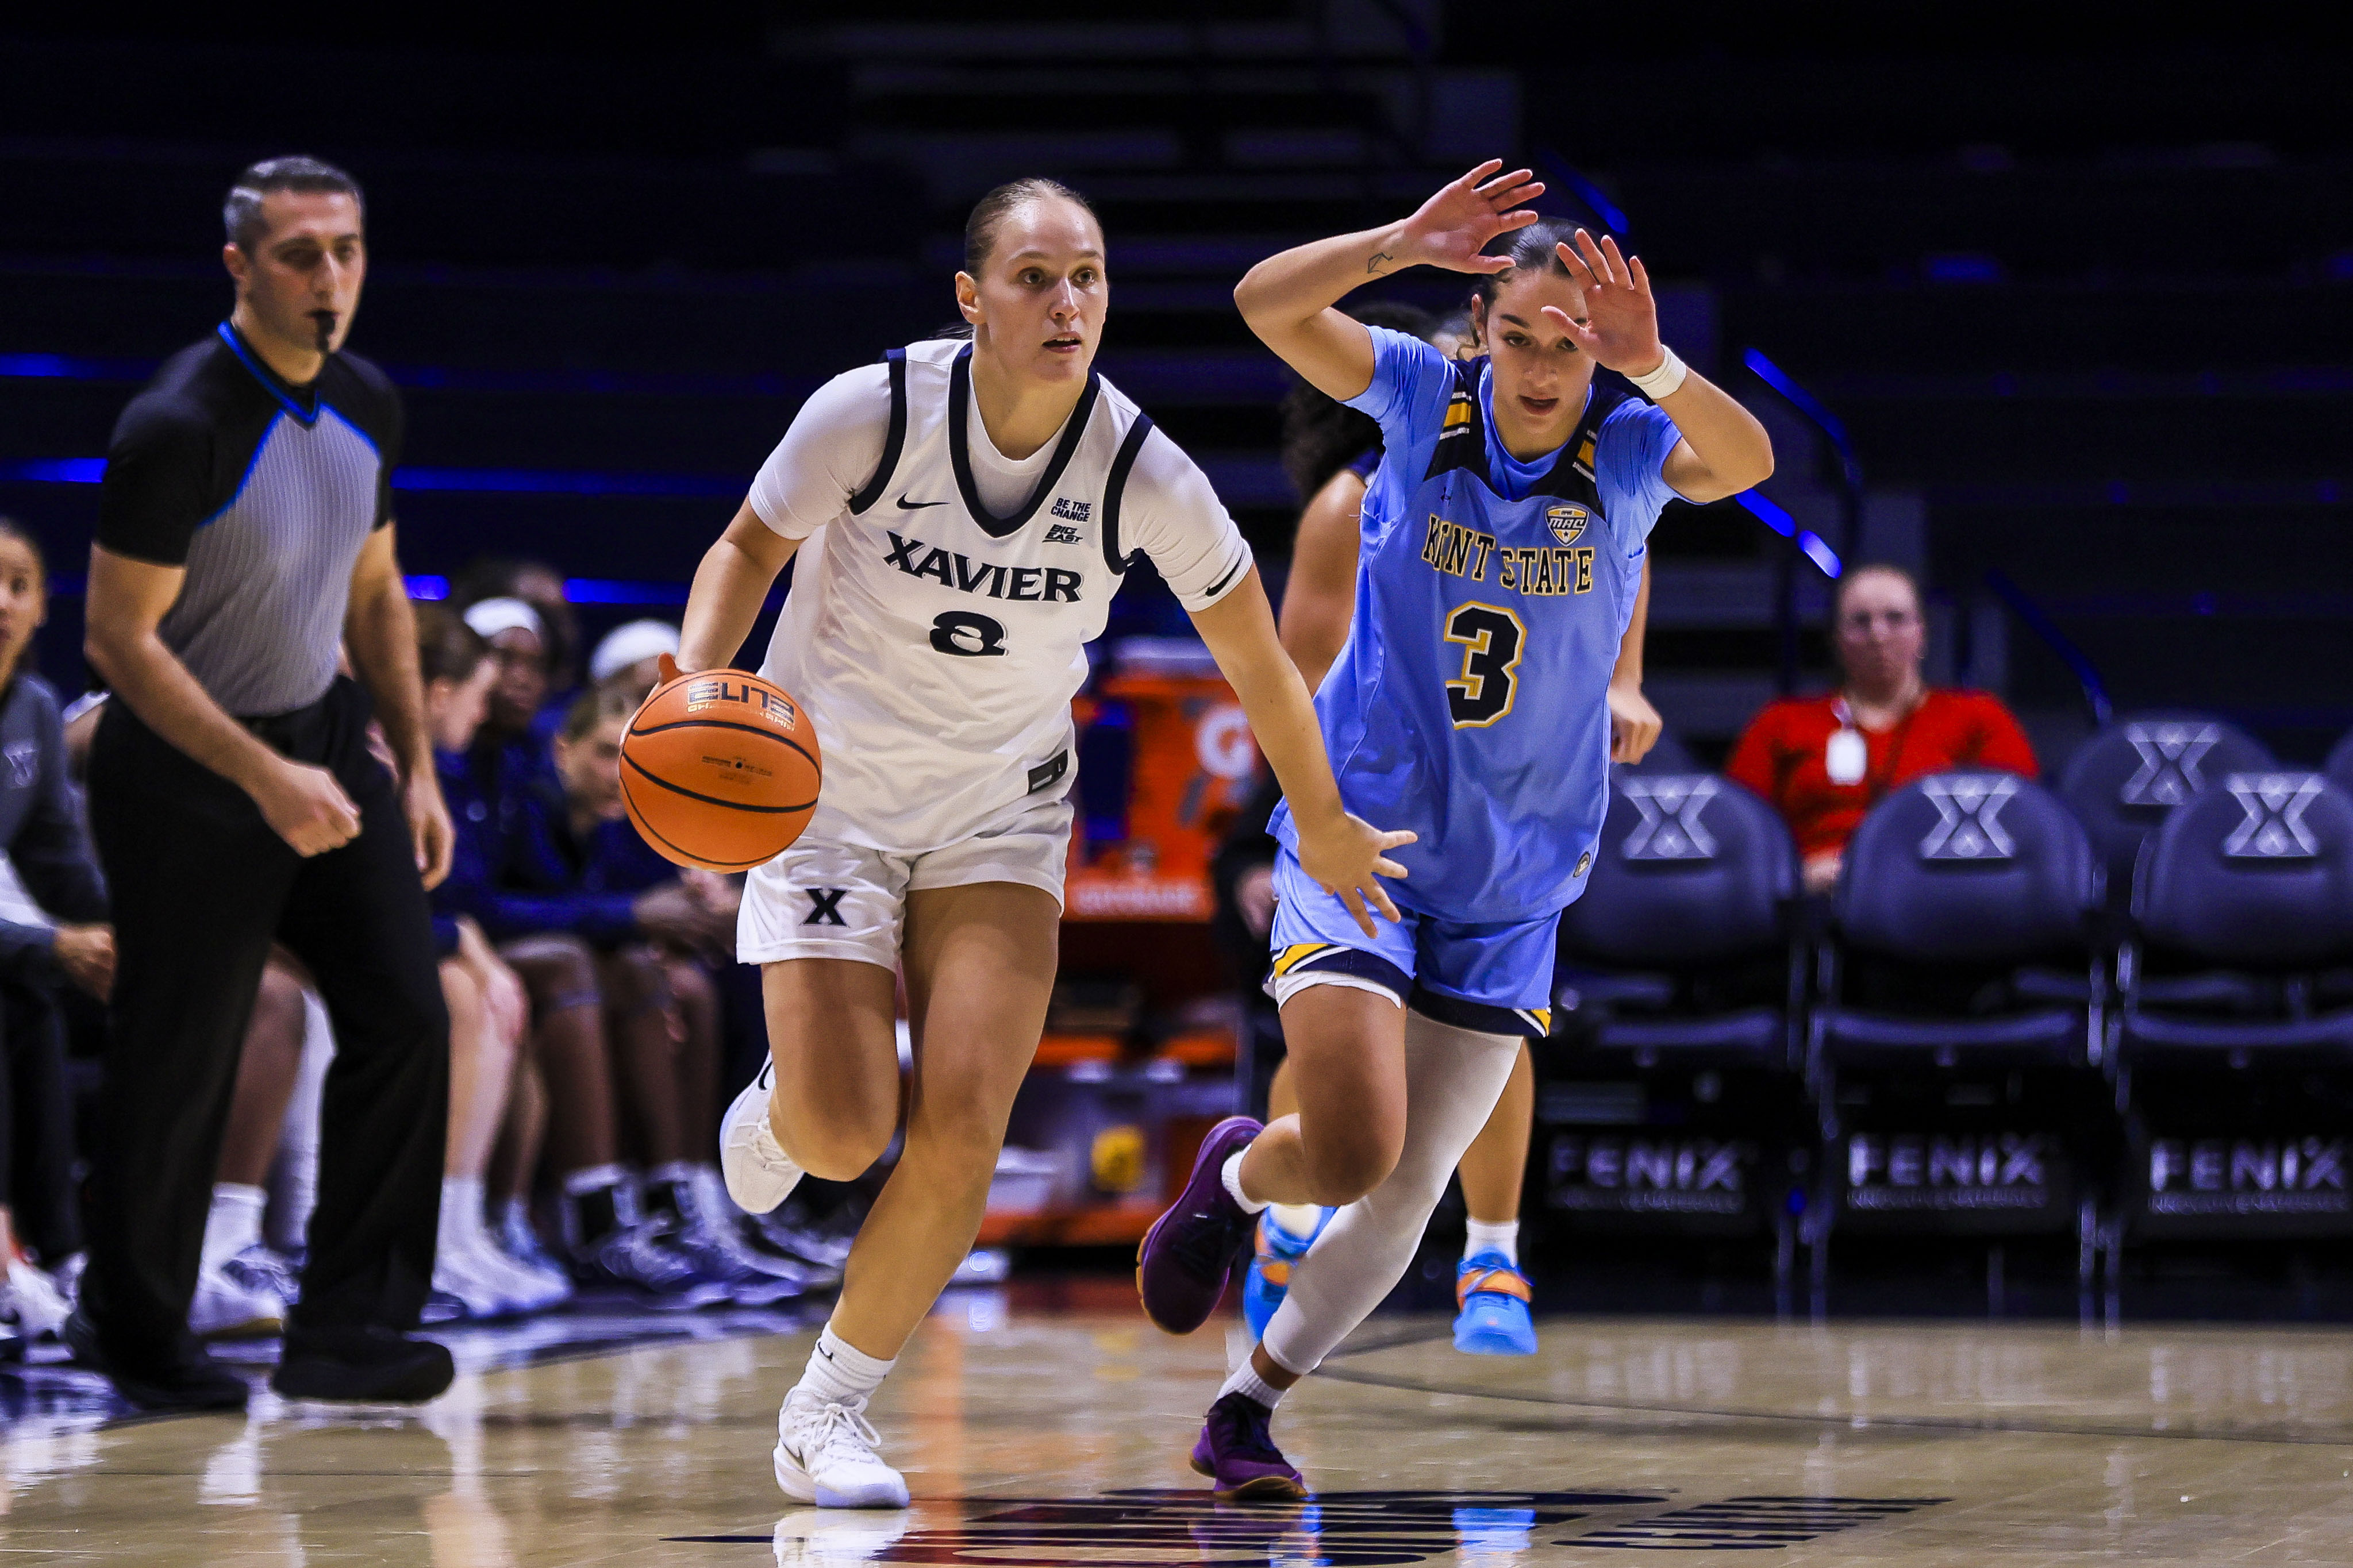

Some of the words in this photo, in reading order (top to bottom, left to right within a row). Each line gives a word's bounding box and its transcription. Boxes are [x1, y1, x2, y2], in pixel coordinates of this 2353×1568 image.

[1051, 506, 1090, 522] CHANGE
[1056, 497, 1070, 508] BE
[1072, 501, 1091, 513] THE
[1550, 518, 1585, 529] MAC
[1045, 532, 1083, 542] EAST
[1049, 524, 1078, 534] BIG
[883, 530, 1083, 603] XAVIER
[1500, 546, 1595, 596] STATE
[929, 611, 1009, 657] 8
[1443, 600, 1528, 730] 3
[802, 888, 851, 927] X
[1550, 1135, 1750, 1191] FENIX
[1848, 1132, 2049, 1187] FENIX
[2149, 1136, 2345, 1191] FENIX
